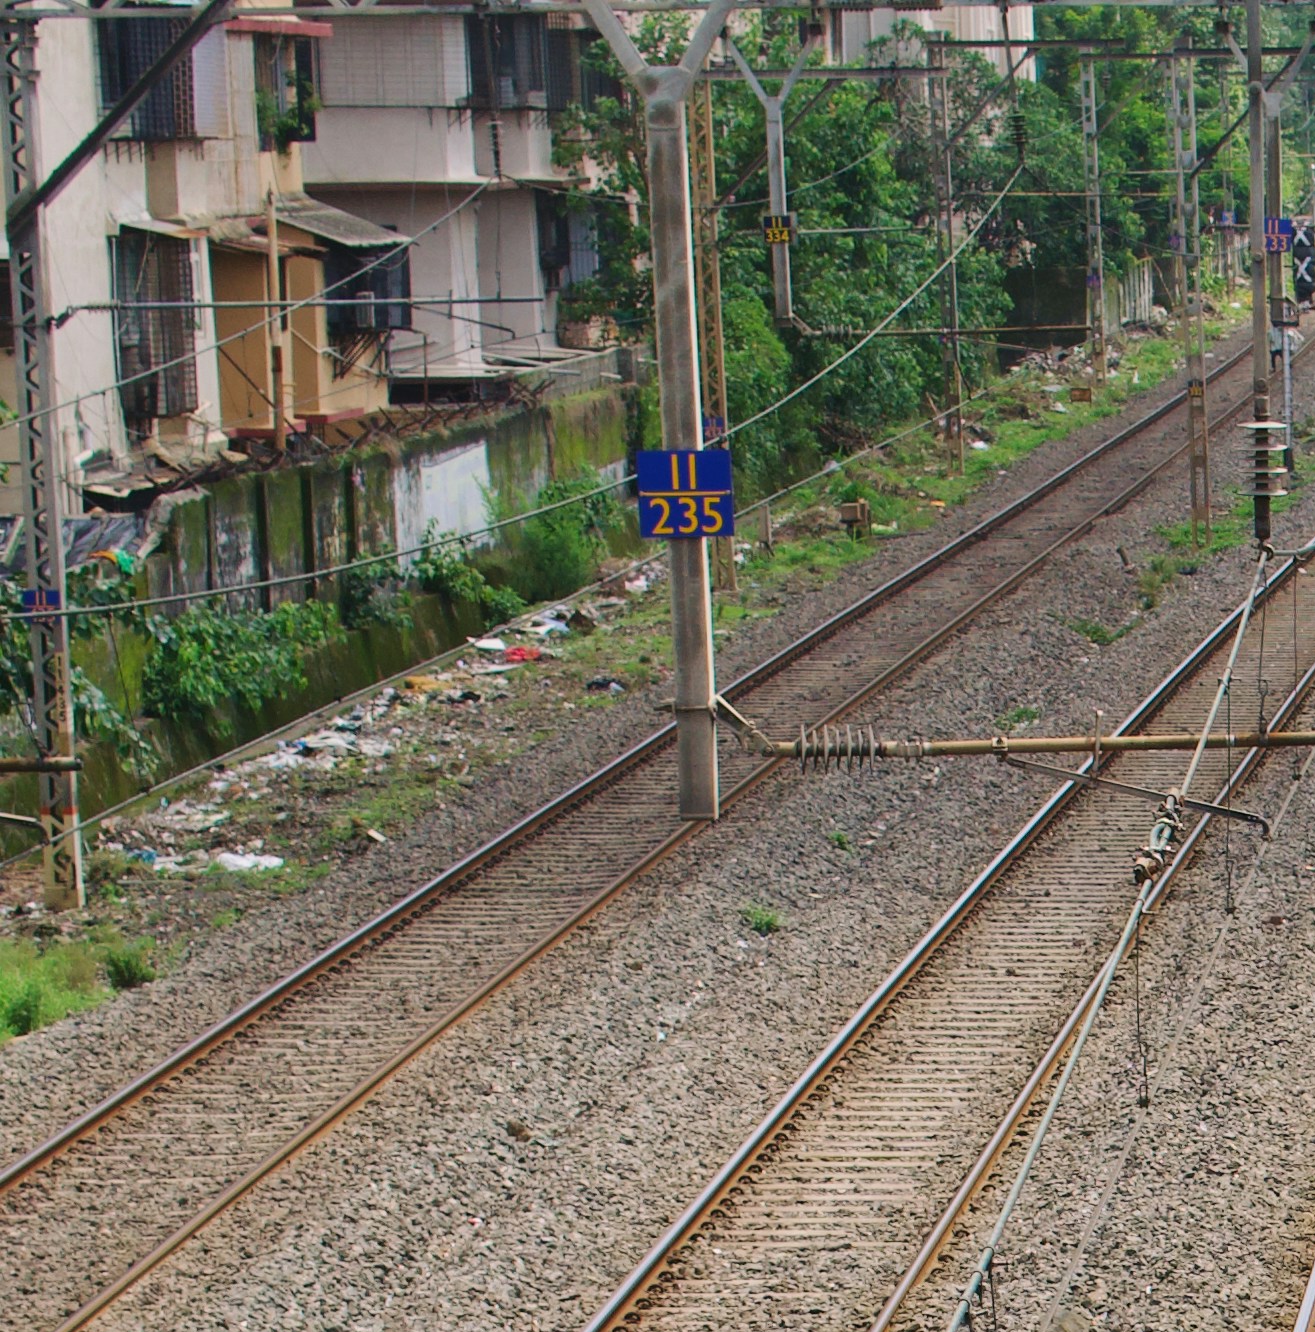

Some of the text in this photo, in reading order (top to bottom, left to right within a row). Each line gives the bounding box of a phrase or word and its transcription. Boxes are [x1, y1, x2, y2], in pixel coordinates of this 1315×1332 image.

[766, 229, 789, 242] 334
[1265, 236, 1287, 251] 33
[670, 453, 697, 490] 11
[650, 496, 723, 534] 235
